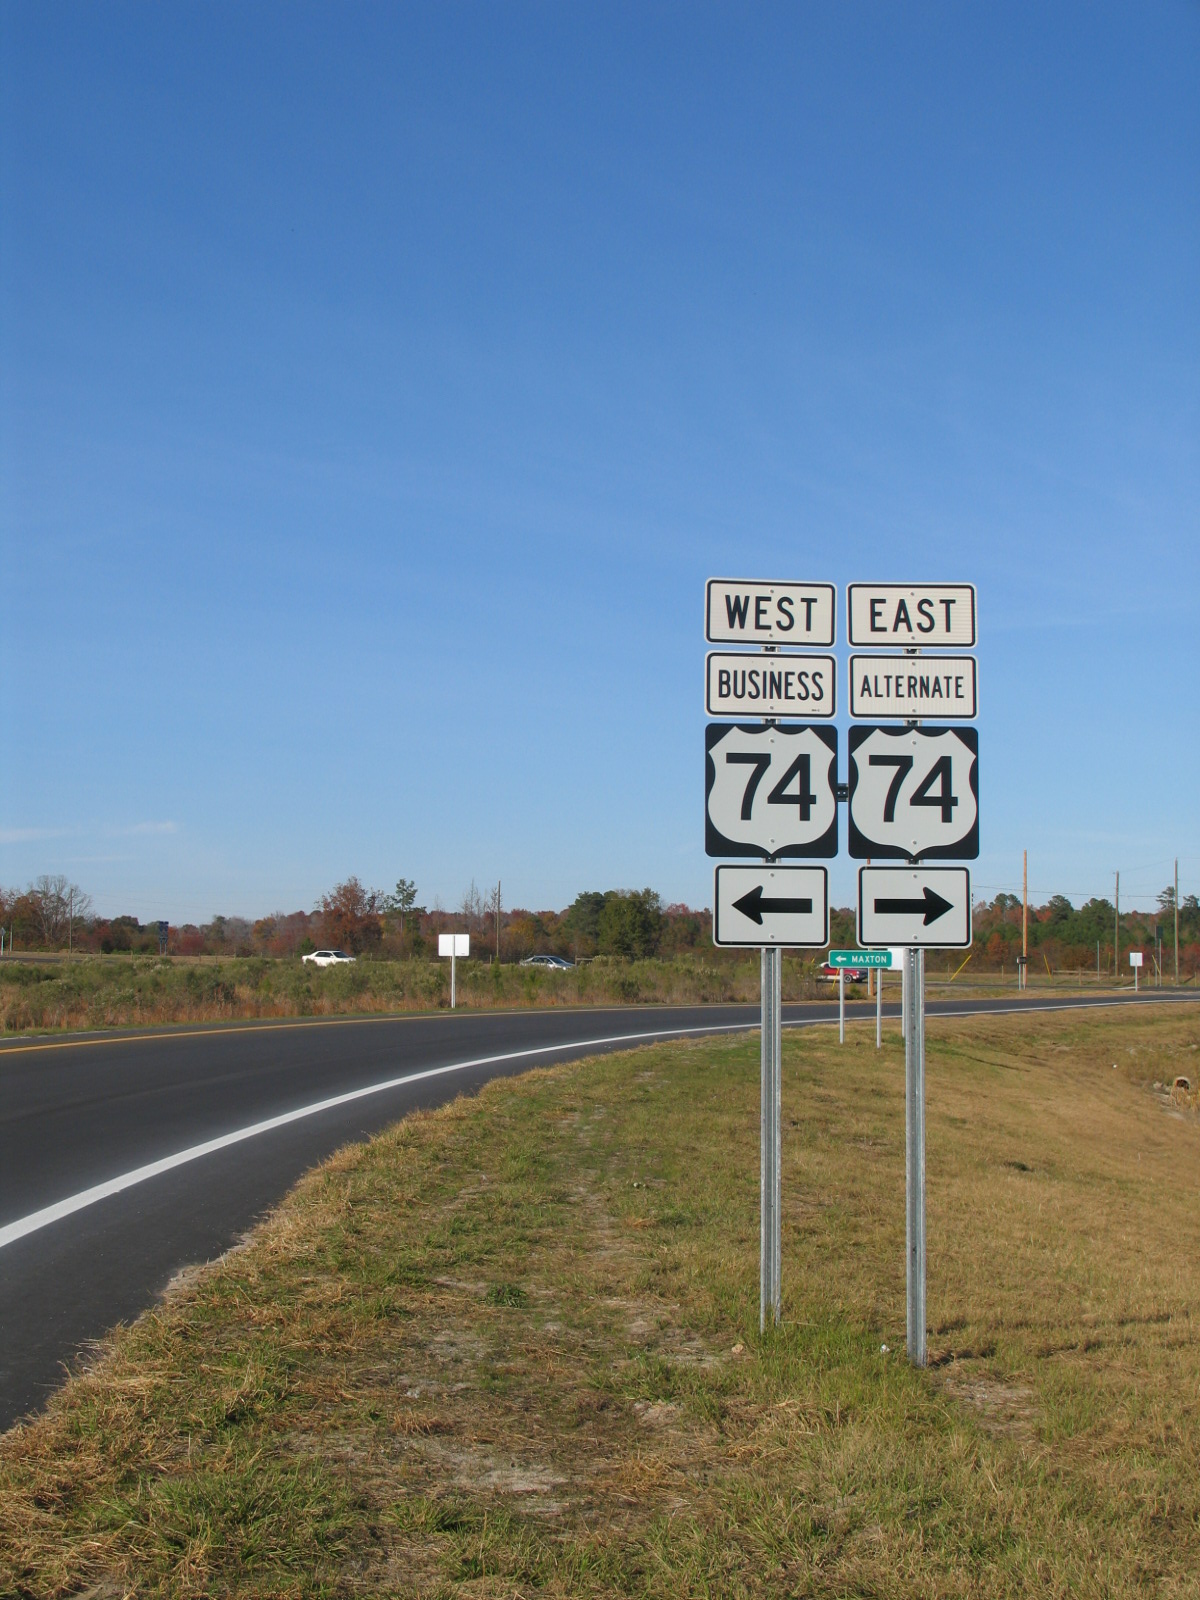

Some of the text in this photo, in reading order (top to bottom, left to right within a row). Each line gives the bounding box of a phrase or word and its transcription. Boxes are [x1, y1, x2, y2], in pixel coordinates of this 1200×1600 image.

[724, 594, 818, 632] WEST
[869, 598, 957, 633] EAST
[718, 669, 824, 702] BUSINESS
[860, 675, 965, 699] ALTERNATE
[726, 752, 817, 822] 74
[868, 754, 959, 824] 74
[851, 955, 887, 963] MAXTON
